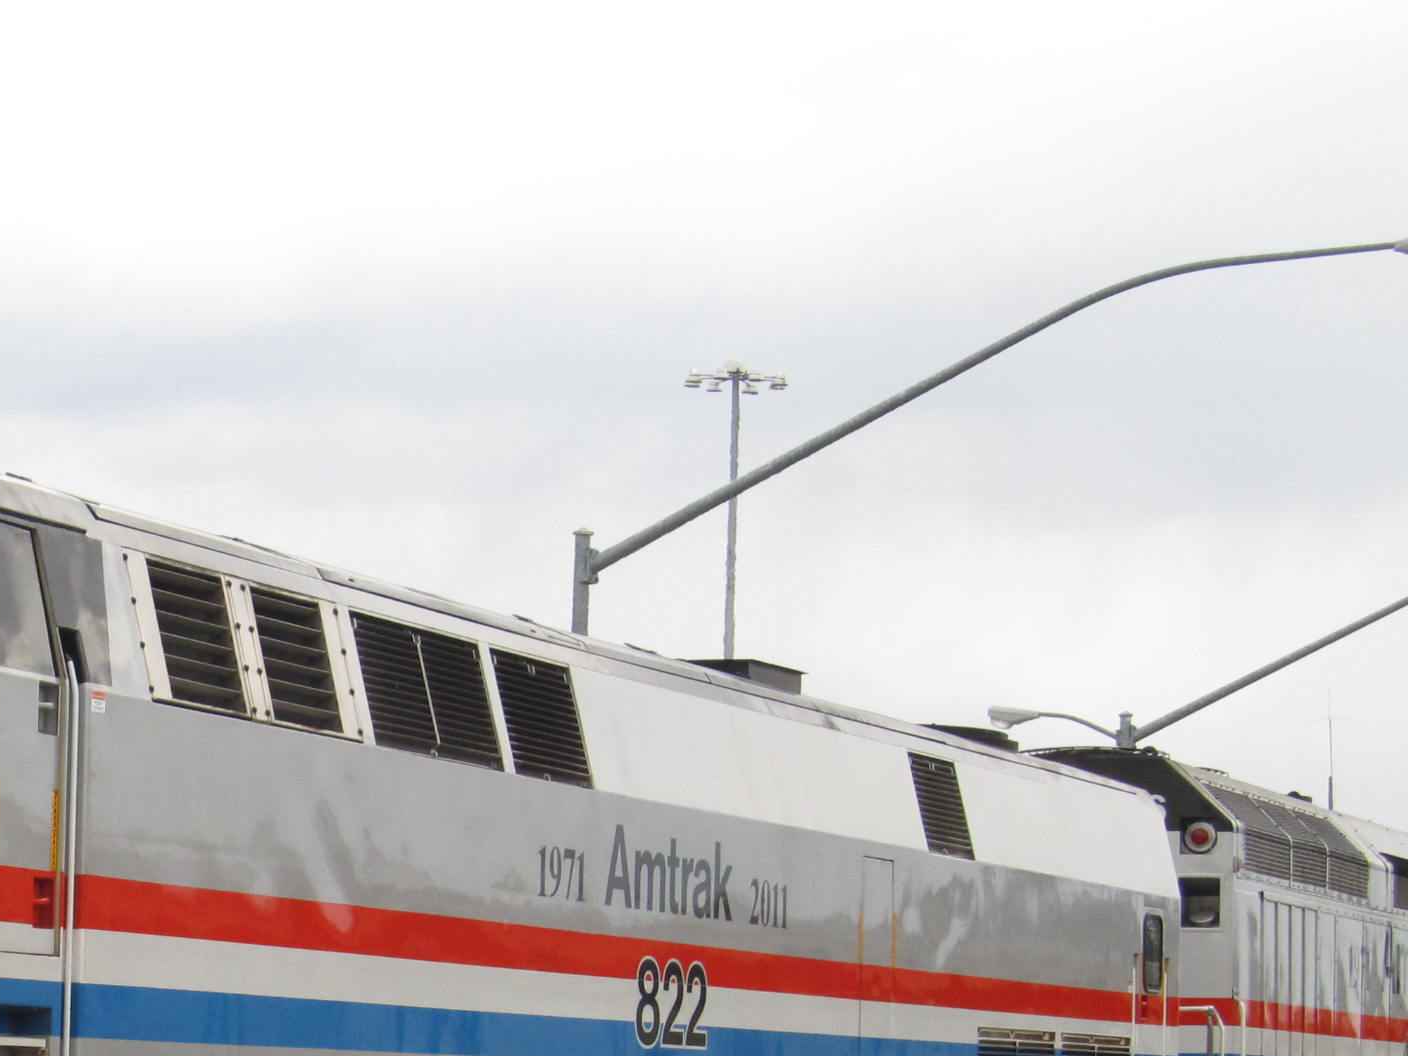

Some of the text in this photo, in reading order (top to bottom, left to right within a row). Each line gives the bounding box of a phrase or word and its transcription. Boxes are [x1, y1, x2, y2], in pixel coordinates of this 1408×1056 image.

[536, 824, 788, 929] 1971 Amtrak 2011
[634, 956, 708, 1049] 822
